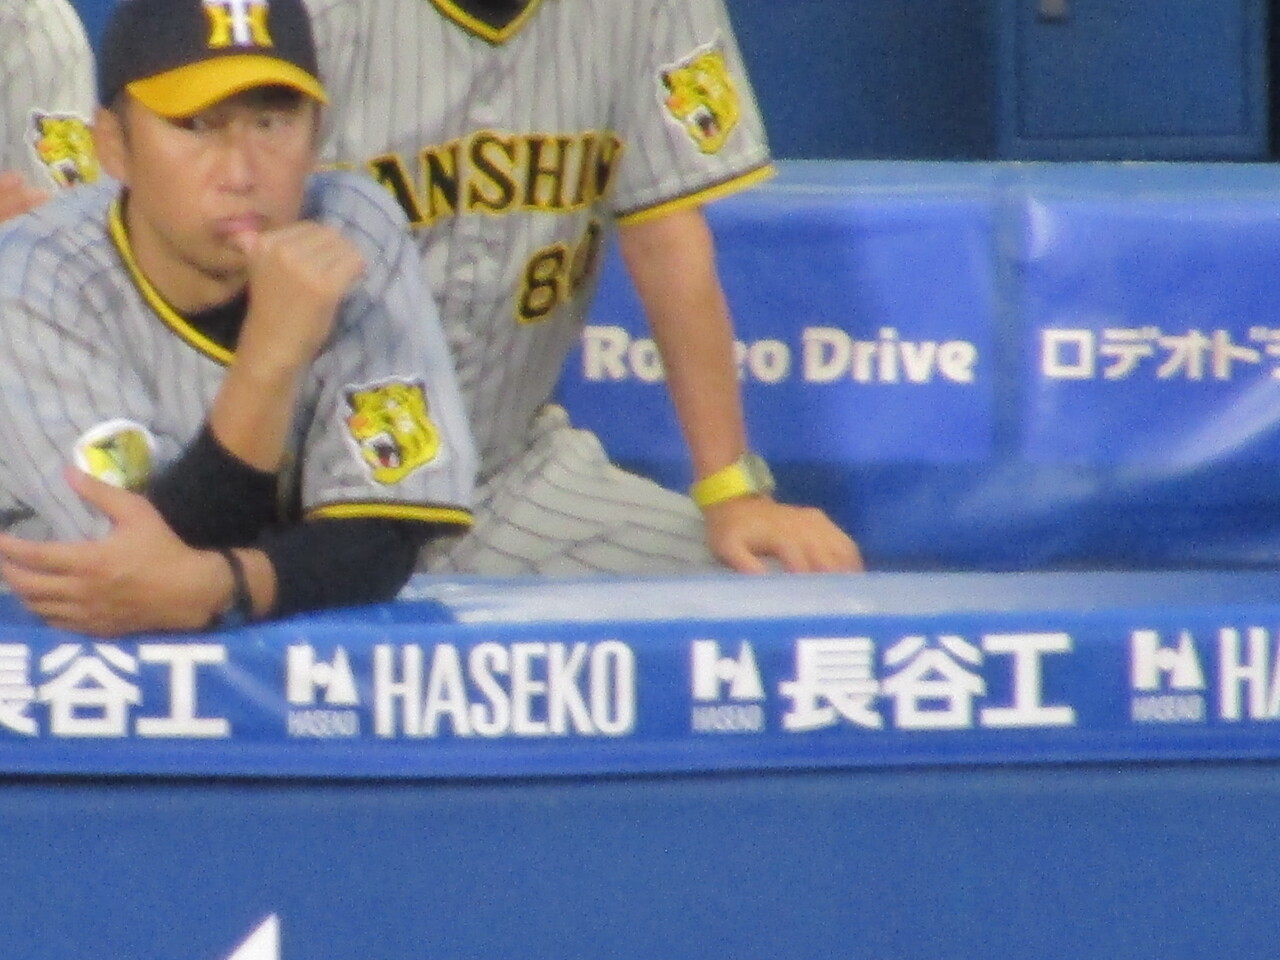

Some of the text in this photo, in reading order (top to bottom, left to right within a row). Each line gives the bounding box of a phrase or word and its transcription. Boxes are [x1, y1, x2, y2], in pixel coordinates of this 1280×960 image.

[802, 325, 979, 385] Drive
[1042, 325, 1280, 380] ロデオド
[372, 640, 635, 738] HASEKO
[778, 632, 1078, 732] 長谷工
